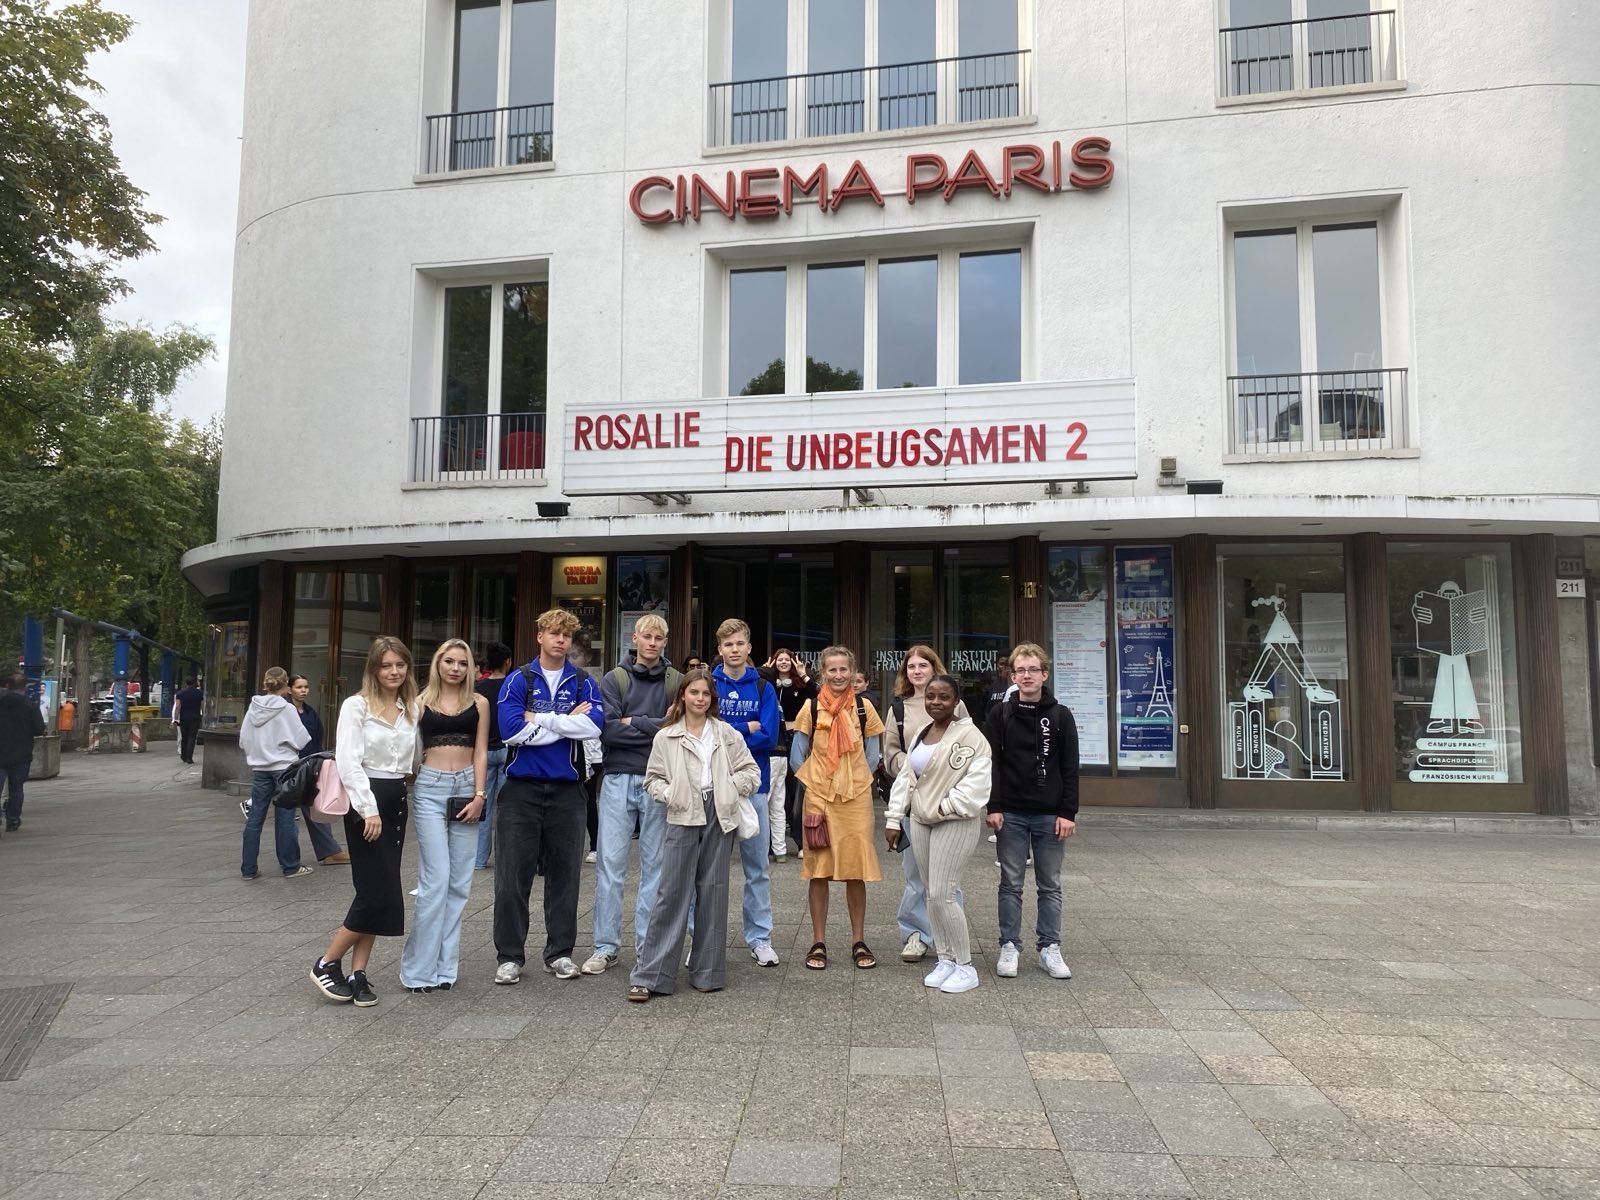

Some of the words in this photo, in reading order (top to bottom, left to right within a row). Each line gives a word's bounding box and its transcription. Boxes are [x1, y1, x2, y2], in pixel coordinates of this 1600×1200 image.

[629, 159, 885, 225] CINEMA
[905, 136, 1115, 205] PARIS
[575, 410, 701, 451] ROSALIE
[725, 434, 773, 474] DIE
[786, 423, 1047, 472] UNBEUGSAMEN
[1065, 421, 1089, 461] 2
[563, 565, 602, 576] CINEMA
[1560, 560, 1580, 572] 211
[1561, 582, 1579, 593] 211
[876, 650, 908, 661] INSTIT
[951, 650, 998, 661] INSTITUT
[876, 660, 902, 671] FRAN
[951, 660, 997, 673] FRANÇAI
